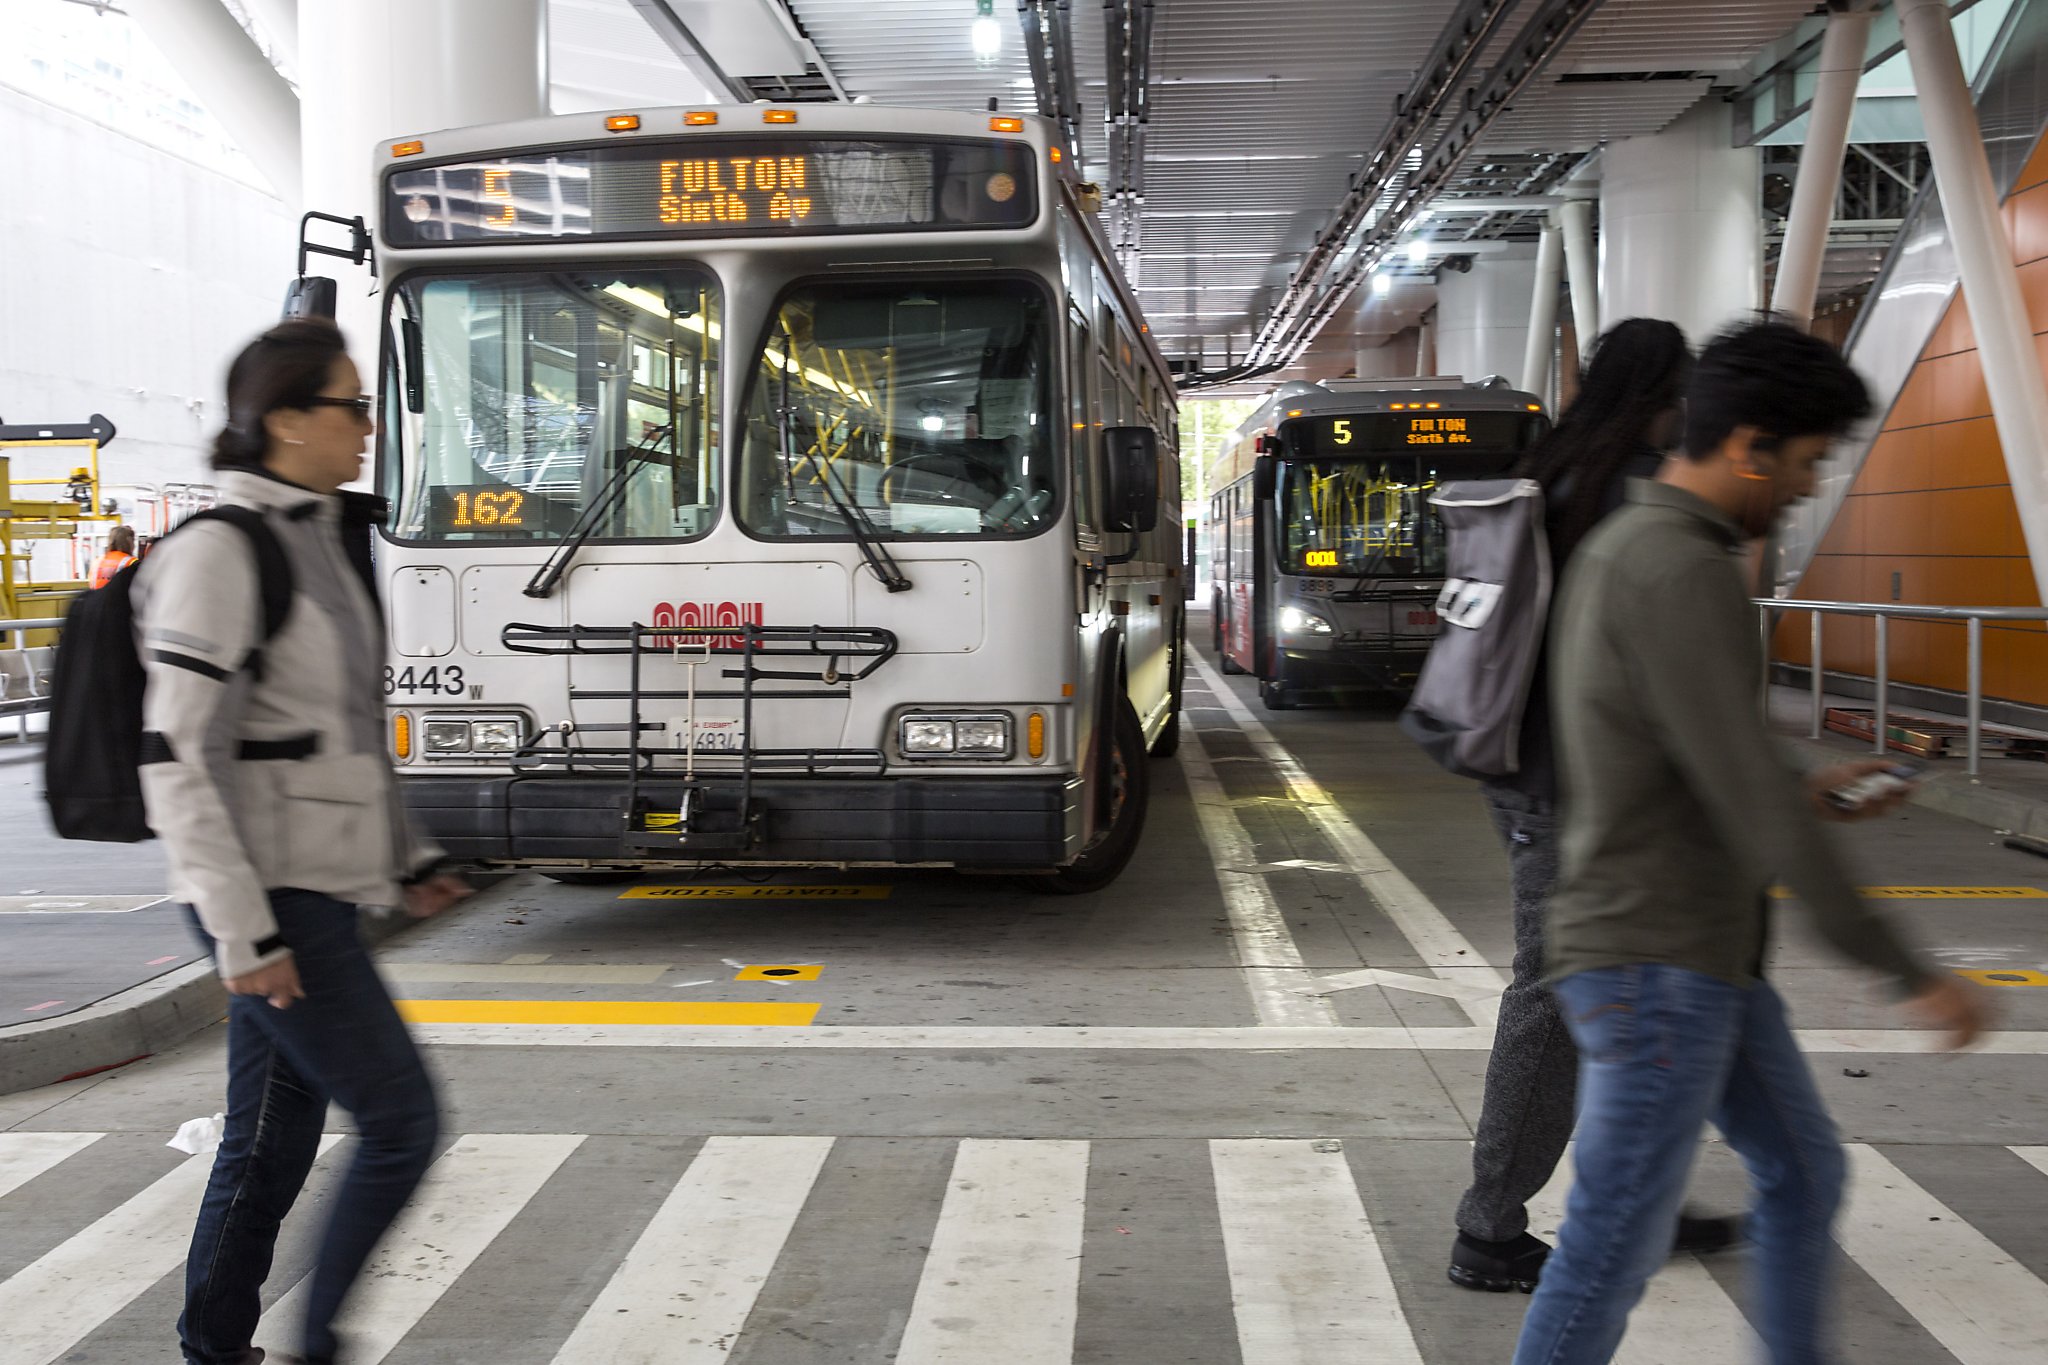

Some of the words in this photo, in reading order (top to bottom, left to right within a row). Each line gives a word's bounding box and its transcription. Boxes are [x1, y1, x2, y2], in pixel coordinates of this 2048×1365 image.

[661, 156, 805, 192] FULTON
[484, 169, 515, 228] 5
[659, 194, 747, 222] Sixth
[769, 192, 811, 219] Av
[1333, 420, 1352, 445] 5
[1406, 433, 1444, 444] Sixth
[1411, 418, 1467, 431] FULTON
[453, 491, 524, 525] 162
[1305, 550, 1339, 567] 001
[383, 665, 465, 695] 8443
